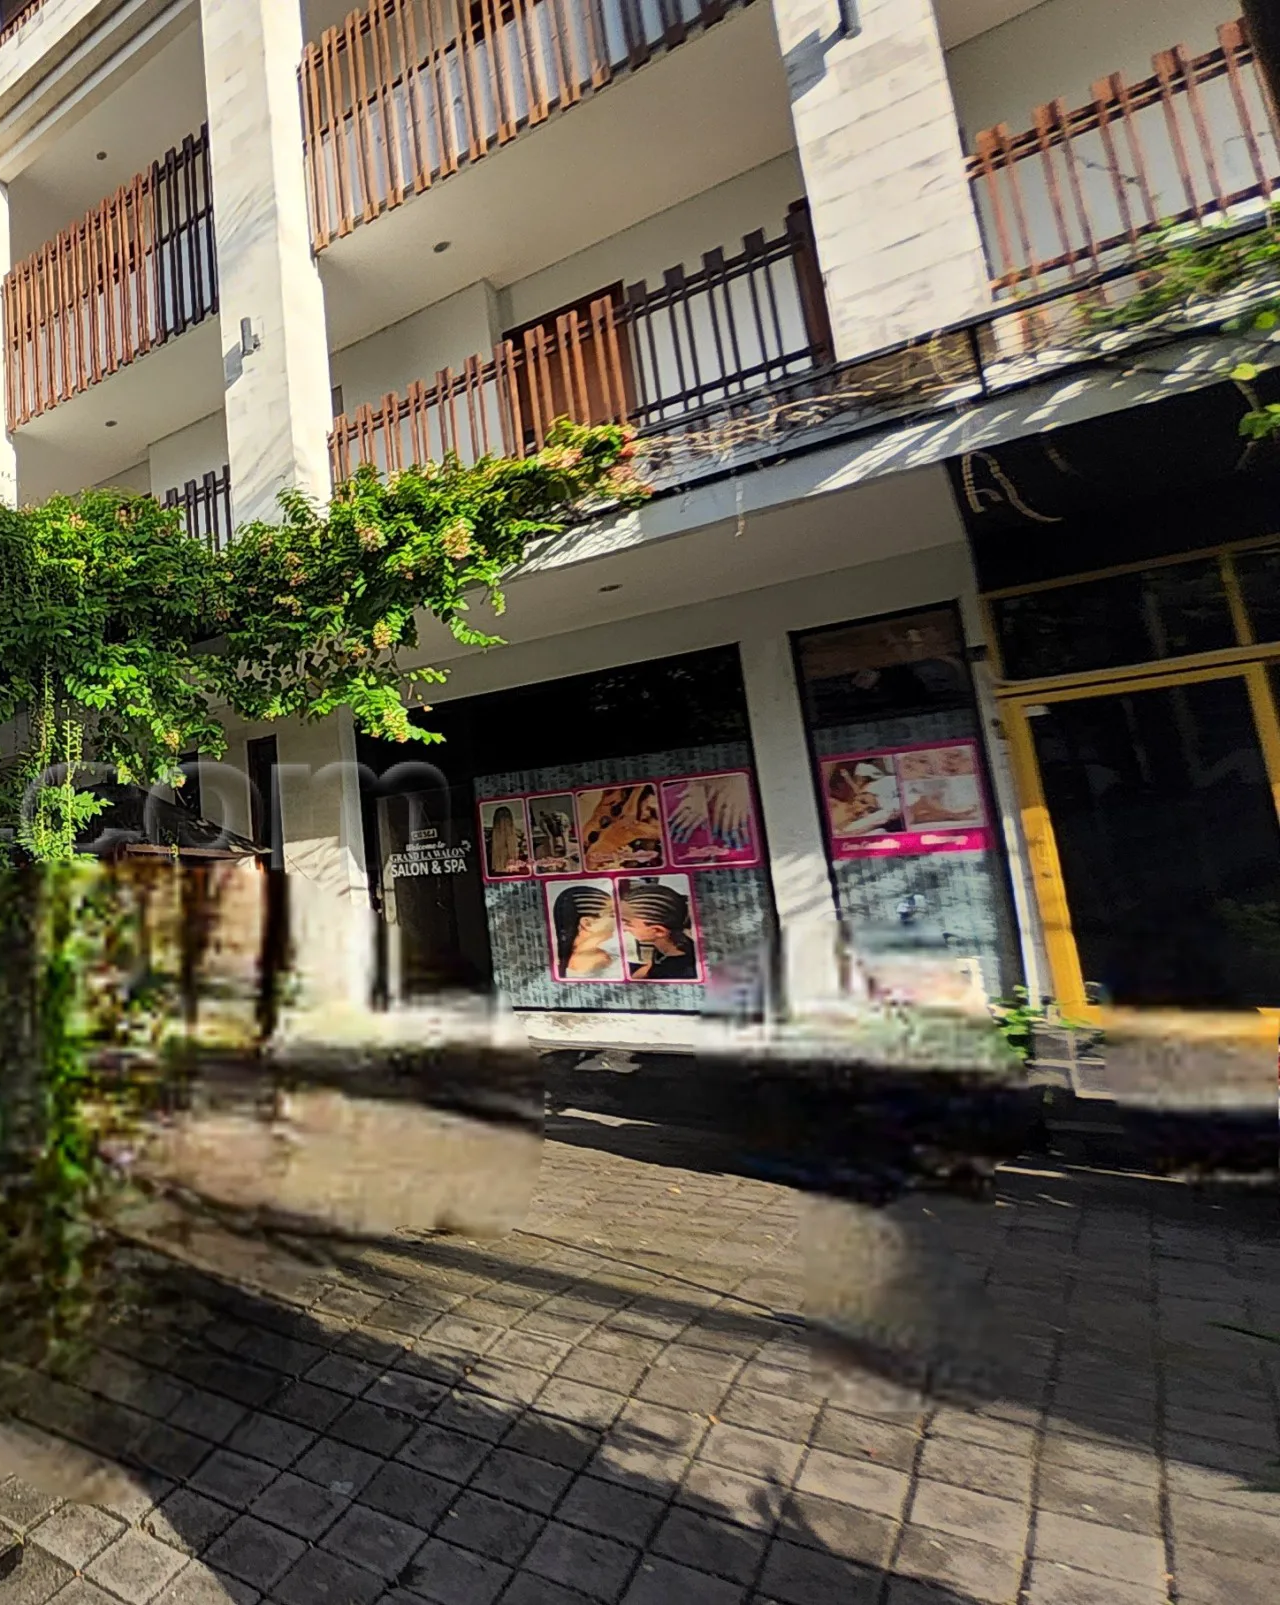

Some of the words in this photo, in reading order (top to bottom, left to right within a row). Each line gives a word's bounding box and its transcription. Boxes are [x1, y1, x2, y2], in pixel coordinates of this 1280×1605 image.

[406, 843, 437, 852] Welcome
[437, 840, 446, 849] to
[389, 852, 419, 863] GRAND
[421, 851, 433, 861] LA
[433, 847, 466, 860] WALON
[391, 861, 429, 878] SALON
[431, 860, 442, 874] &
[443, 858, 468, 874] SPA
